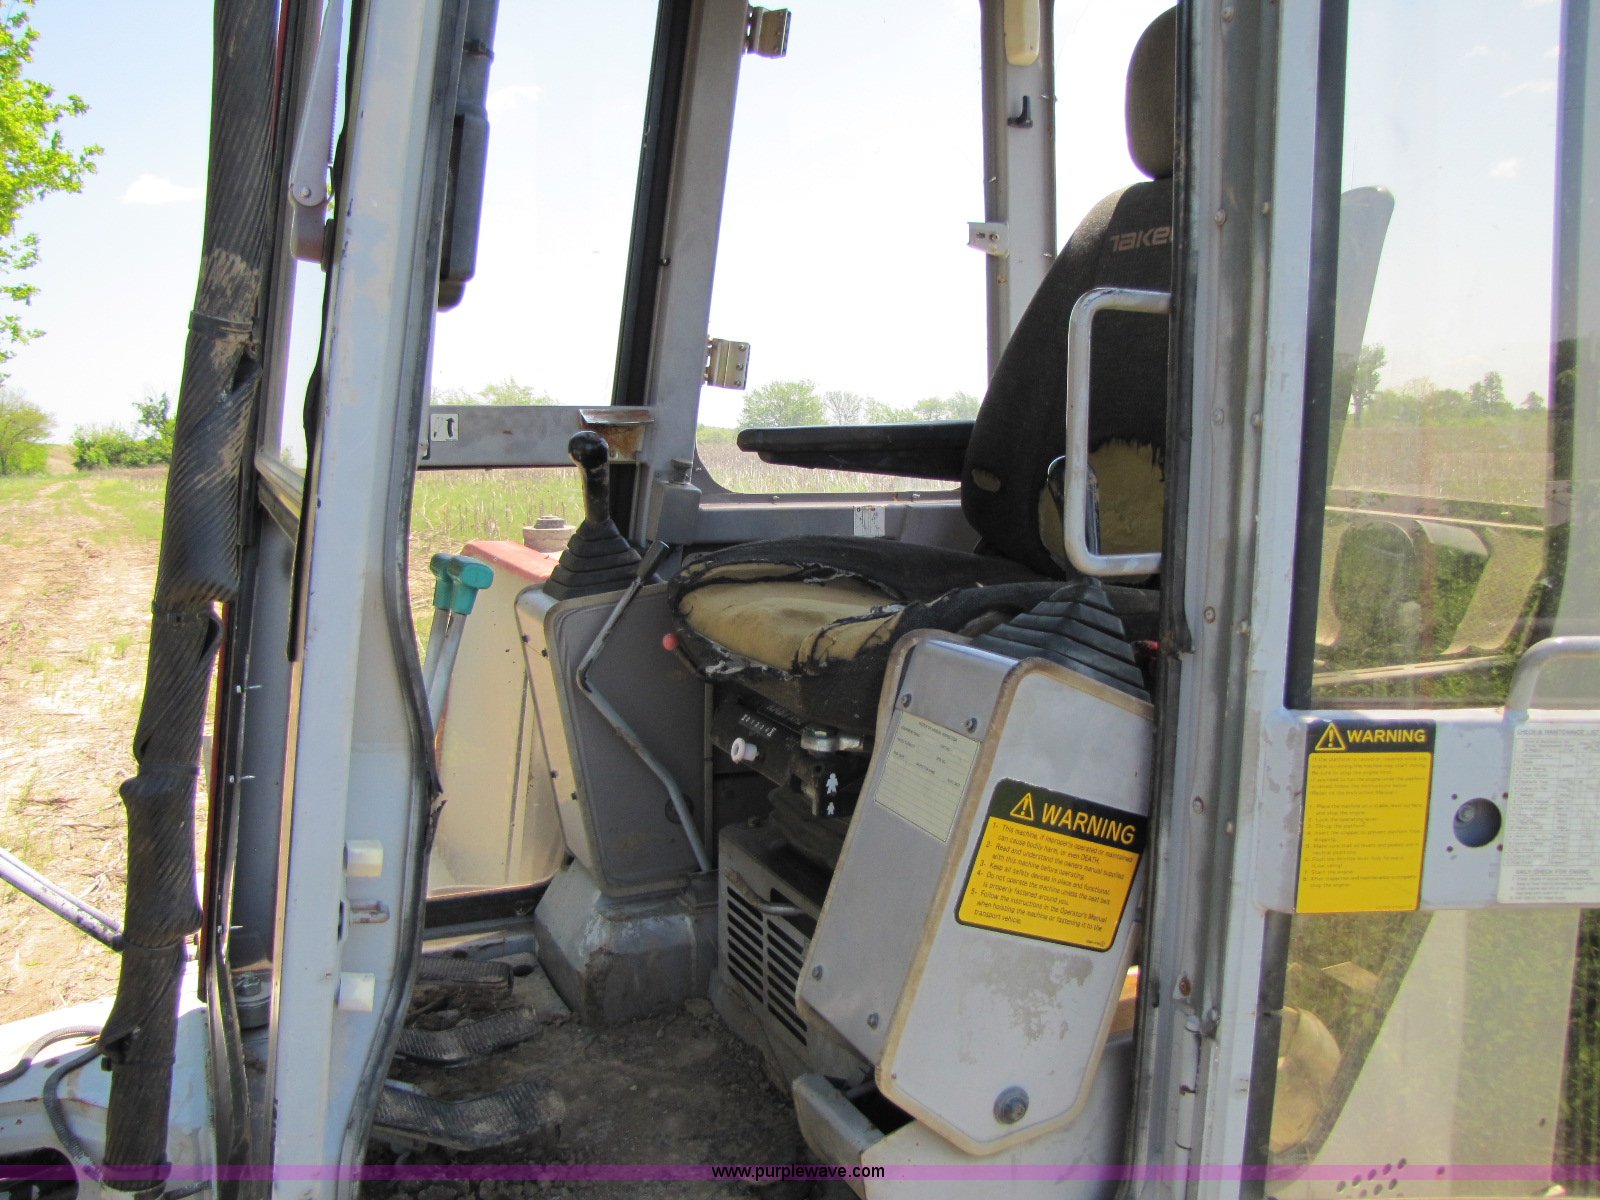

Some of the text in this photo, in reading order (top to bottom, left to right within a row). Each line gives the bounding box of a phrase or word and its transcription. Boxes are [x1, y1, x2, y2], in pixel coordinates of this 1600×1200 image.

[1347, 729, 1427, 743] WARNING
[1042, 802, 1136, 845] WARNING
[991, 853, 1005, 861] with
[1017, 859, 1040, 869] machine
[1039, 864, 1058, 873] before
[994, 843, 1010, 852] Read
[1010, 847, 1022, 855] and
[1083, 864, 1102, 874] manual
[988, 862, 1004, 872] Keep
[1011, 867, 1030, 878] safety
[1056, 878, 1072, 887] place
[994, 873, 1005, 881] not
[1005, 876, 1028, 887] operate
[1037, 883, 1060, 893] machine
[988, 882, 1012, 894] properly
[1013, 888, 1038, 898] fastened
[1038, 894, 1057, 902] around
[972, 909, 1001, 921] transport
[976, 899, 992, 908] when
[991, 902, 1015, 914] hoisting
[1025, 910, 1048, 920] machine
[1055, 916, 1081, 928] fastening
[979, 889, 999, 899] Follow
[1009, 896, 1043, 909] instructions
[1087, 913, 1107, 922] Manual
